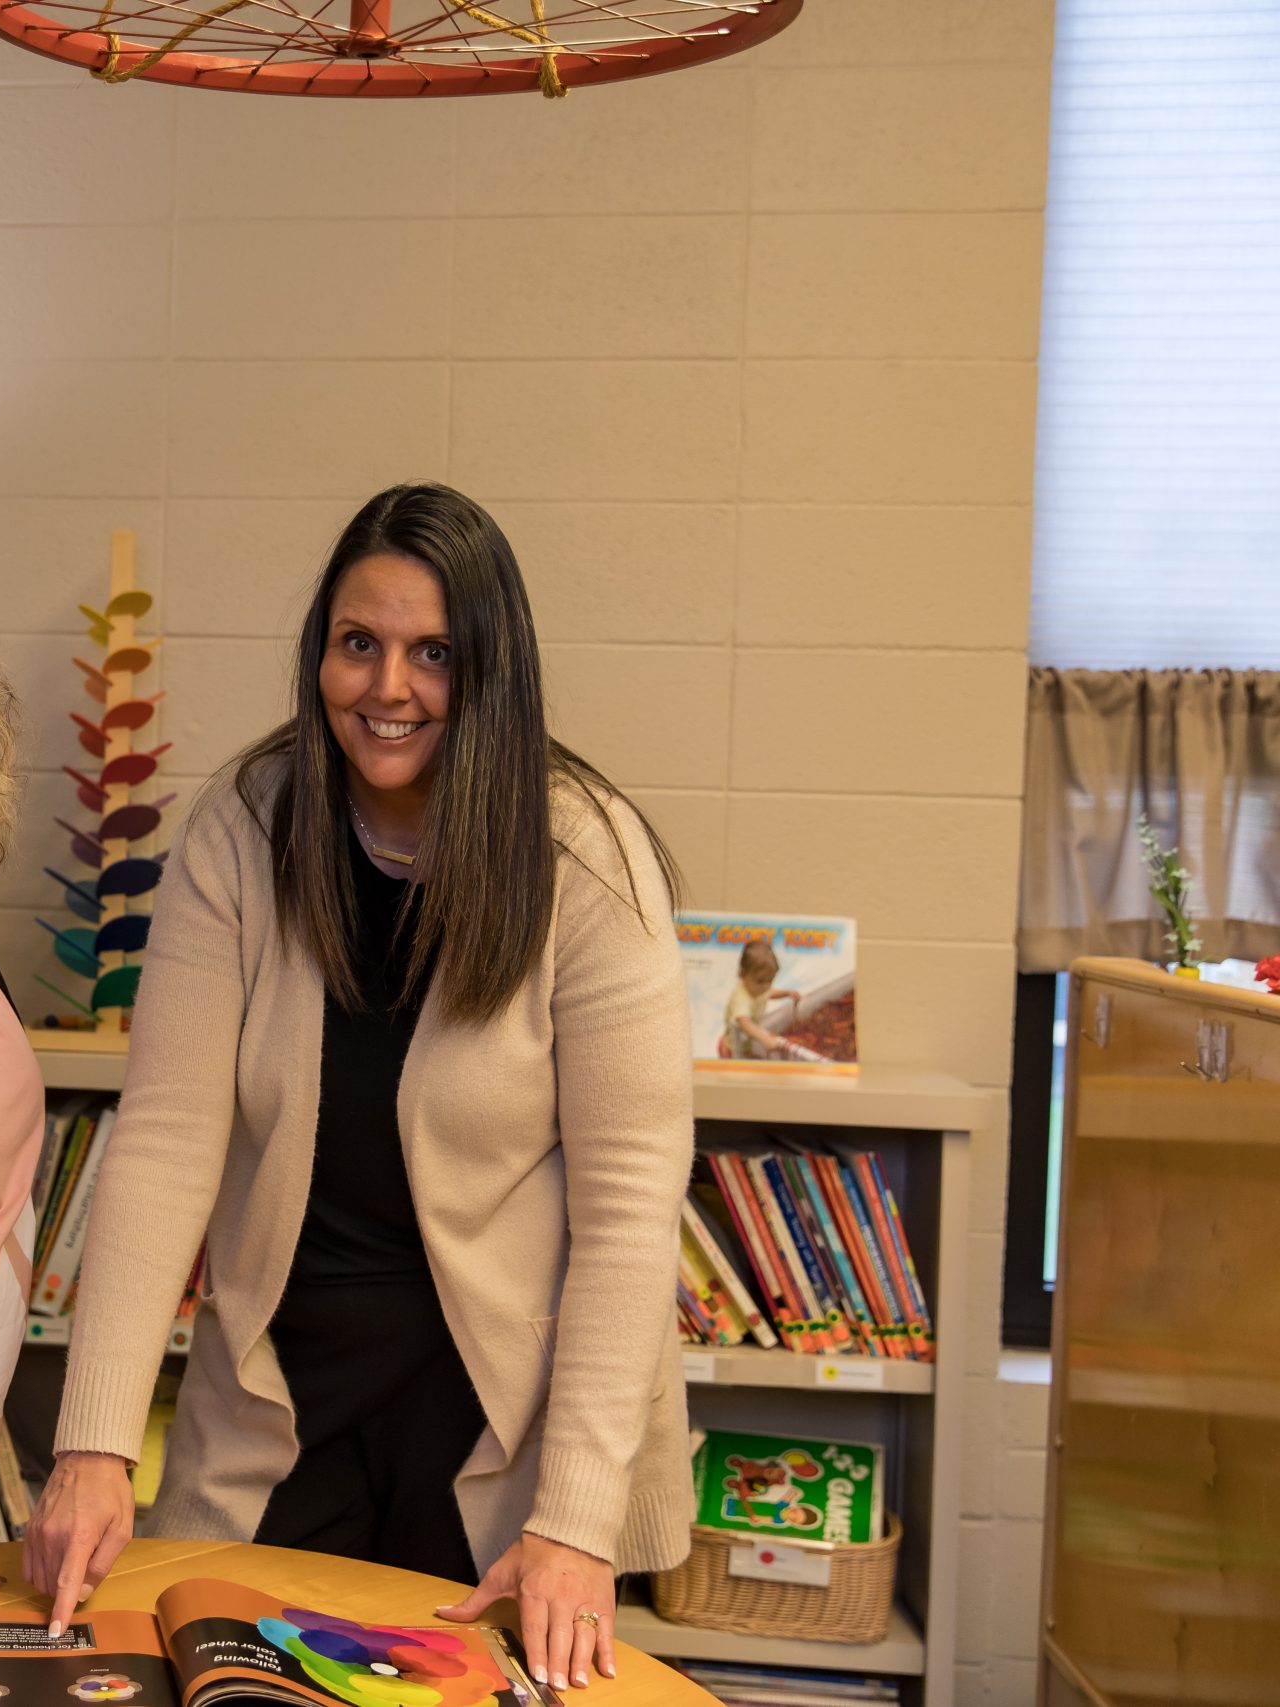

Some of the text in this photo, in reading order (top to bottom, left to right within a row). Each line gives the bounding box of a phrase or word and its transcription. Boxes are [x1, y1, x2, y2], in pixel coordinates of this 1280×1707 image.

[717, 925, 777, 945] GOOEY
[195, 1641, 276, 1656] color wheel
[214, 1655, 282, 1672] following
[256, 1653, 280, 1664] the
